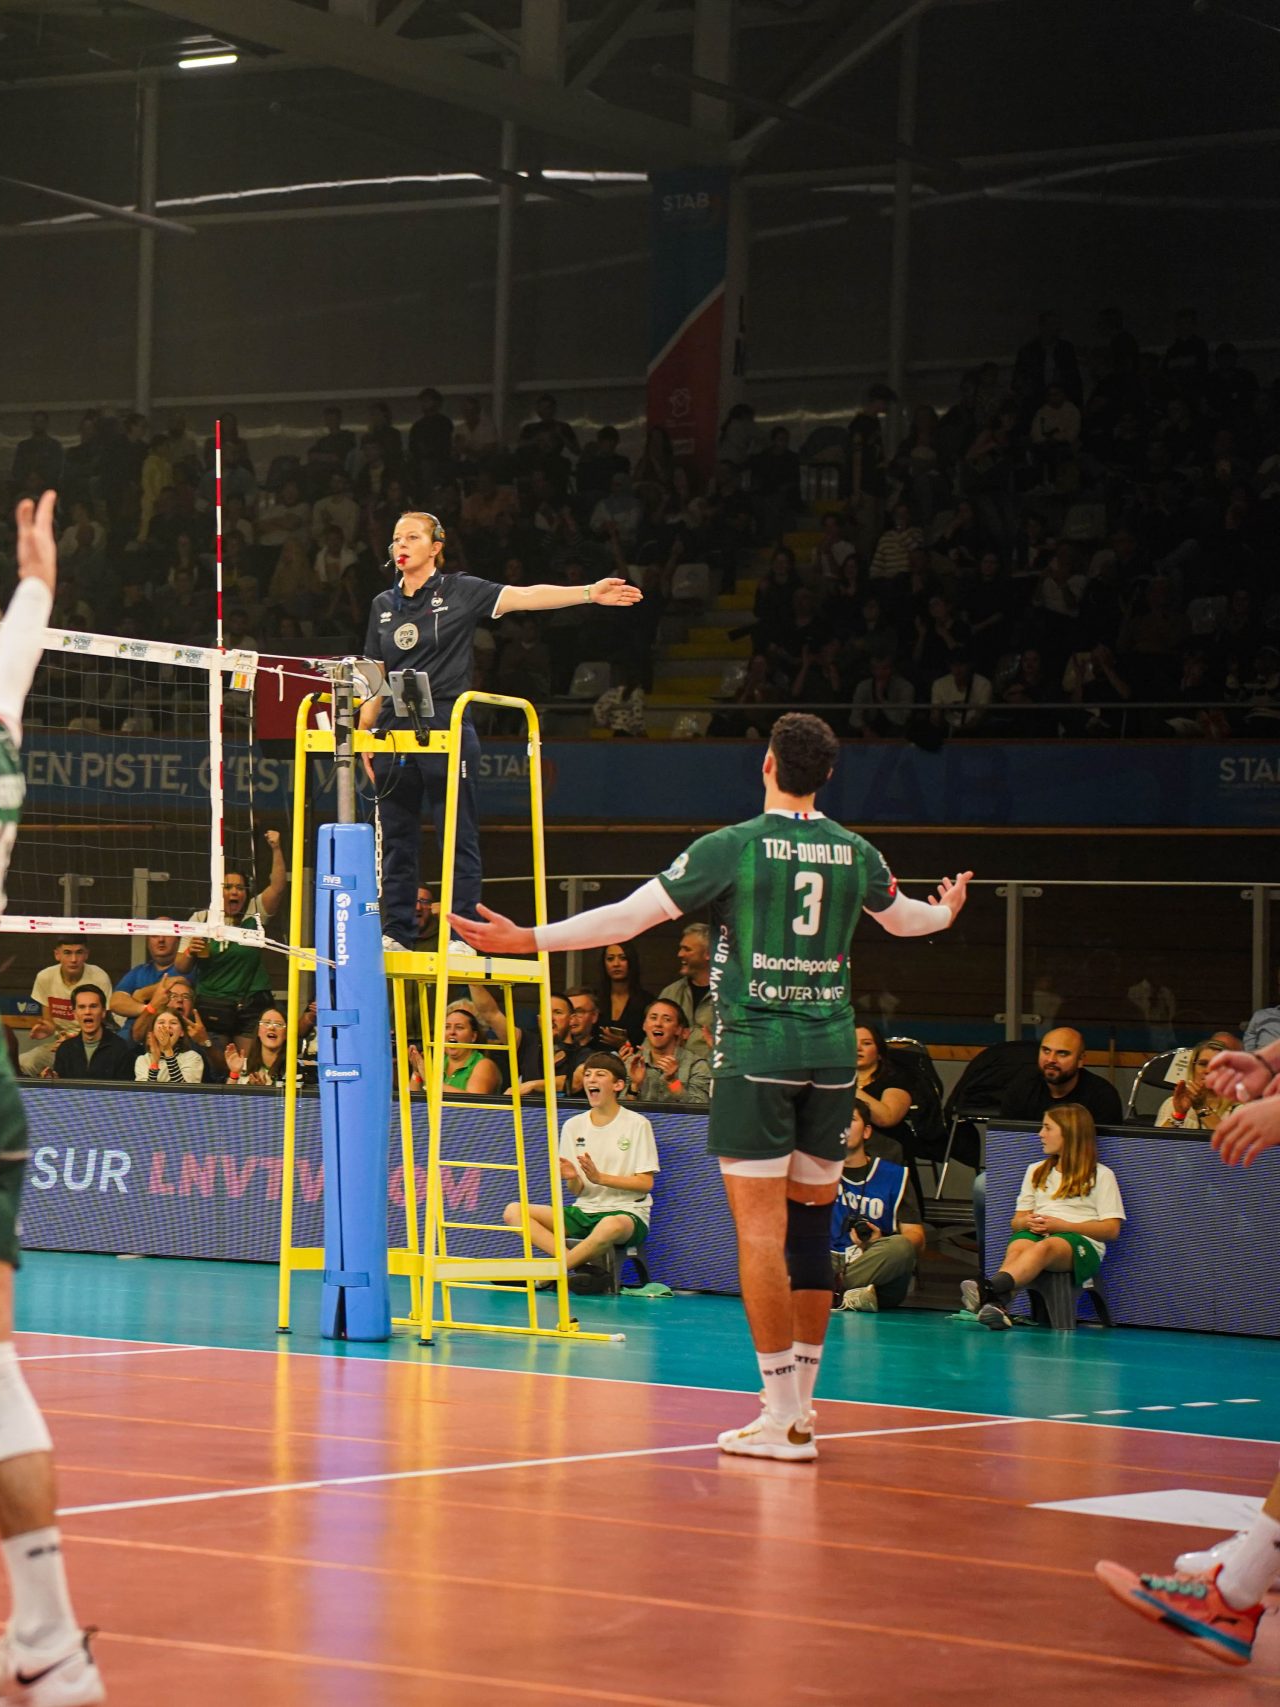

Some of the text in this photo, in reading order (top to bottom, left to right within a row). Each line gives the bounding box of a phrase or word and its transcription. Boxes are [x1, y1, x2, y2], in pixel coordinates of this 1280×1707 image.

[663, 193, 710, 212] STAB
[26, 750, 73, 786] EN
[80, 752, 189, 795] PISTE,
[1219, 757, 1280, 782] STA
[762, 837, 853, 866] TIZI-OUALOU
[791, 870, 824, 936] 3
[336, 909, 350, 966] Senoh
[714, 924, 730, 964] CLUB
[752, 952, 840, 976] Blancheporte
[332, 1069, 360, 1077] Senoh
[30, 1146, 132, 1194] SUR
